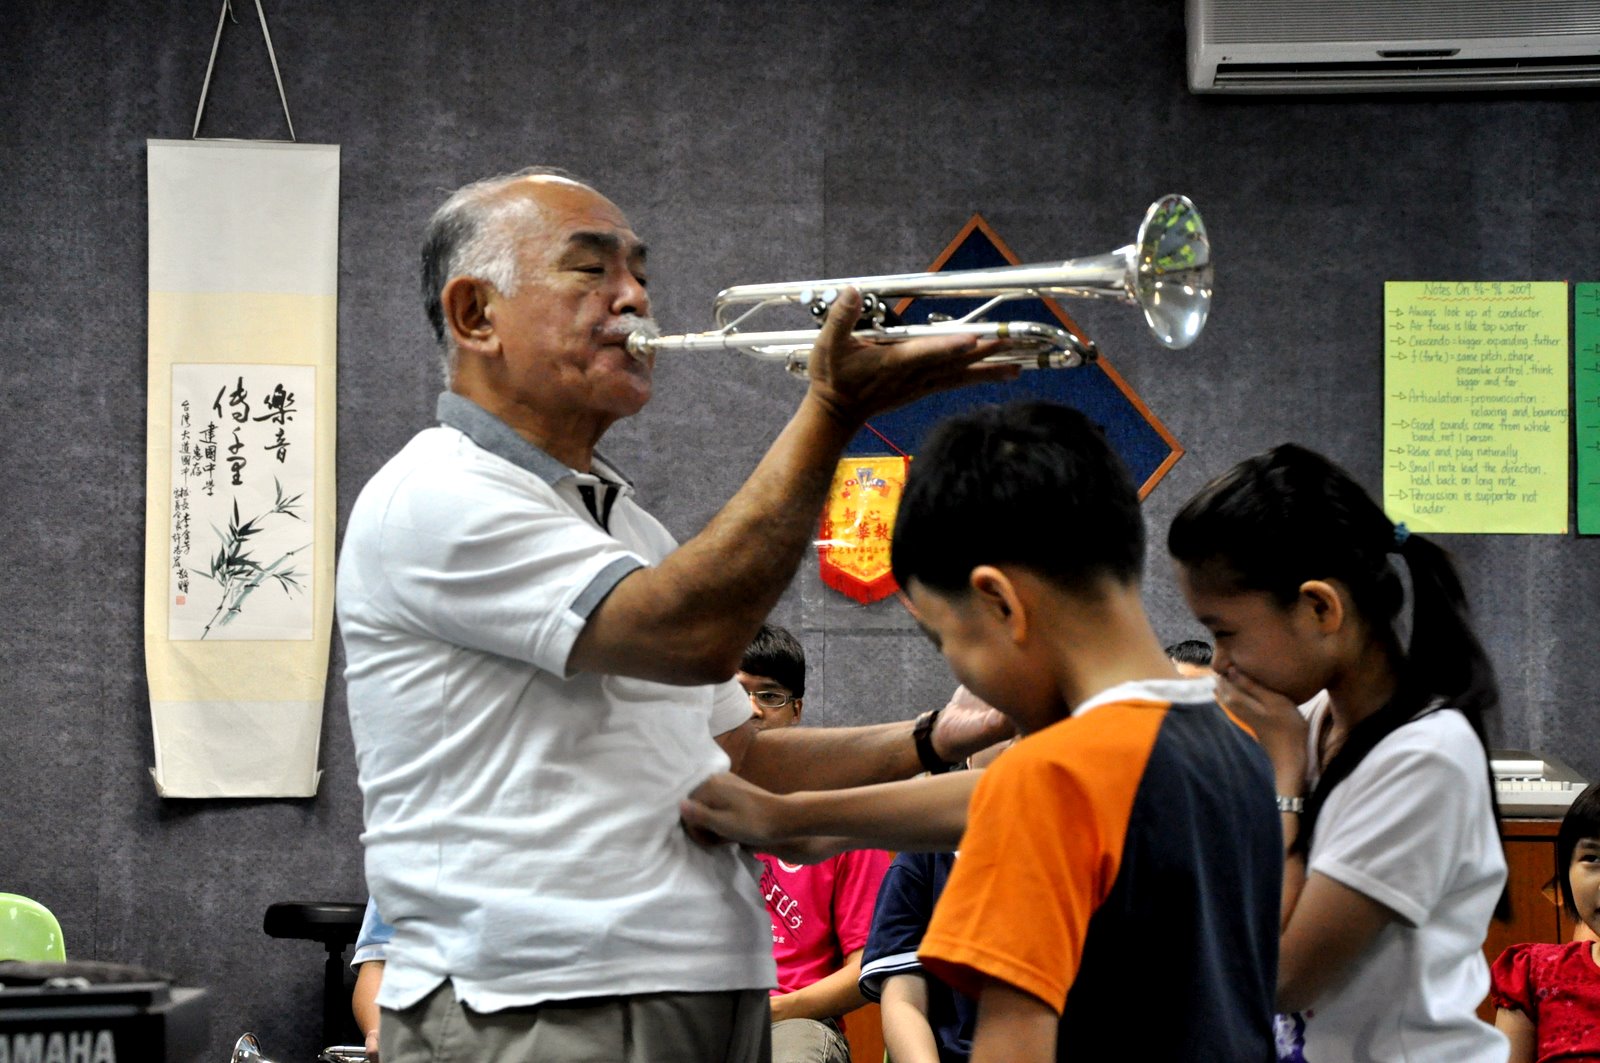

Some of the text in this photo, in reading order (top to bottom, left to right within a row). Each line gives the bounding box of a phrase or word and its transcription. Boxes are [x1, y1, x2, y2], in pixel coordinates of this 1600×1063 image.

[1423, 283, 1451, 295] Notes
[1456, 283, 1470, 295] On
[1509, 283, 1531, 295] 2009
[1408, 305, 1436, 317] Always
[1444, 305, 1459, 316] look
[1466, 308, 1477, 318] up
[1482, 306, 1491, 316] at
[1410, 320, 1423, 331] Air
[1428, 318, 1450, 332] focus
[1455, 322, 1461, 331] is
[1464, 320, 1477, 331] like
[1409, 336, 1449, 347] Crescendo
[1456, 351, 1478, 361] same
[1456, 366, 1492, 375] ensemble
[1457, 376, 1480, 391] bigger
[1484, 377, 1500, 387] and
[1409, 388, 1463, 403] Articulation
[1471, 406, 1507, 421] relaxing
[1512, 406, 1530, 417] and
[1411, 417, 1551, 433] Good sounds come from whole
[1440, 433, 1454, 442] not
[1407, 444, 1431, 456] Relax
[1435, 444, 1450, 456] and
[1455, 446, 1474, 461] play
[1409, 460, 1435, 473] Small
[1438, 463, 1457, 472] note
[1461, 462, 1478, 473] lead
[1484, 463, 1497, 473] the
[1411, 476, 1431, 486] hold
[1436, 475, 1457, 486] back
[1461, 478, 1471, 486] on
[1475, 476, 1493, 491] long
[1409, 488, 1537, 505] Percussion is supporter not
